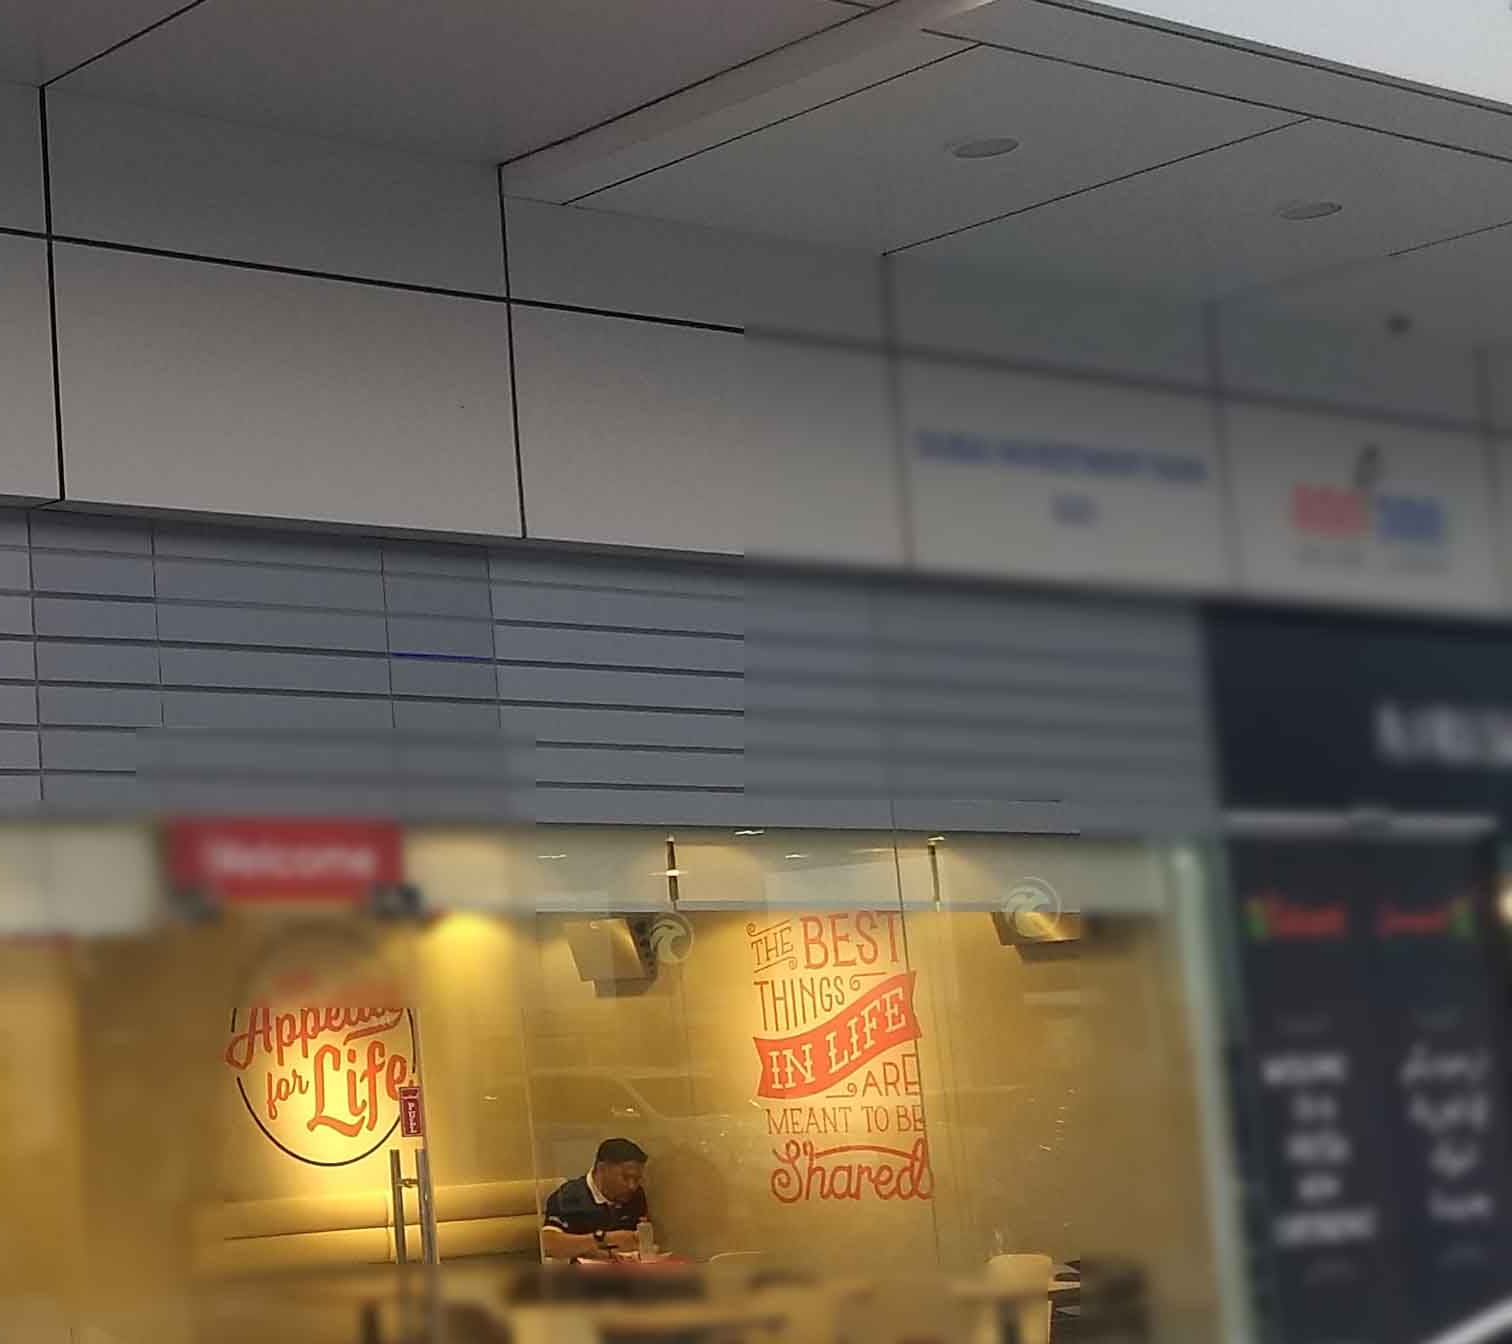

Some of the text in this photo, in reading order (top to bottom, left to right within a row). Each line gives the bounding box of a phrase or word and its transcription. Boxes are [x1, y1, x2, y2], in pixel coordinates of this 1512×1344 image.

[751, 911, 901, 969] THE BEST
[753, 976, 845, 1032] THINGS
[768, 987, 906, 1089] IN LIFE
[267, 1069, 309, 1120] for
[307, 1040, 411, 1137] Life
[862, 1054, 921, 1096] ARE
[765, 1105, 927, 1135] MEANT TO BE
[771, 1137, 935, 1203] Shared
